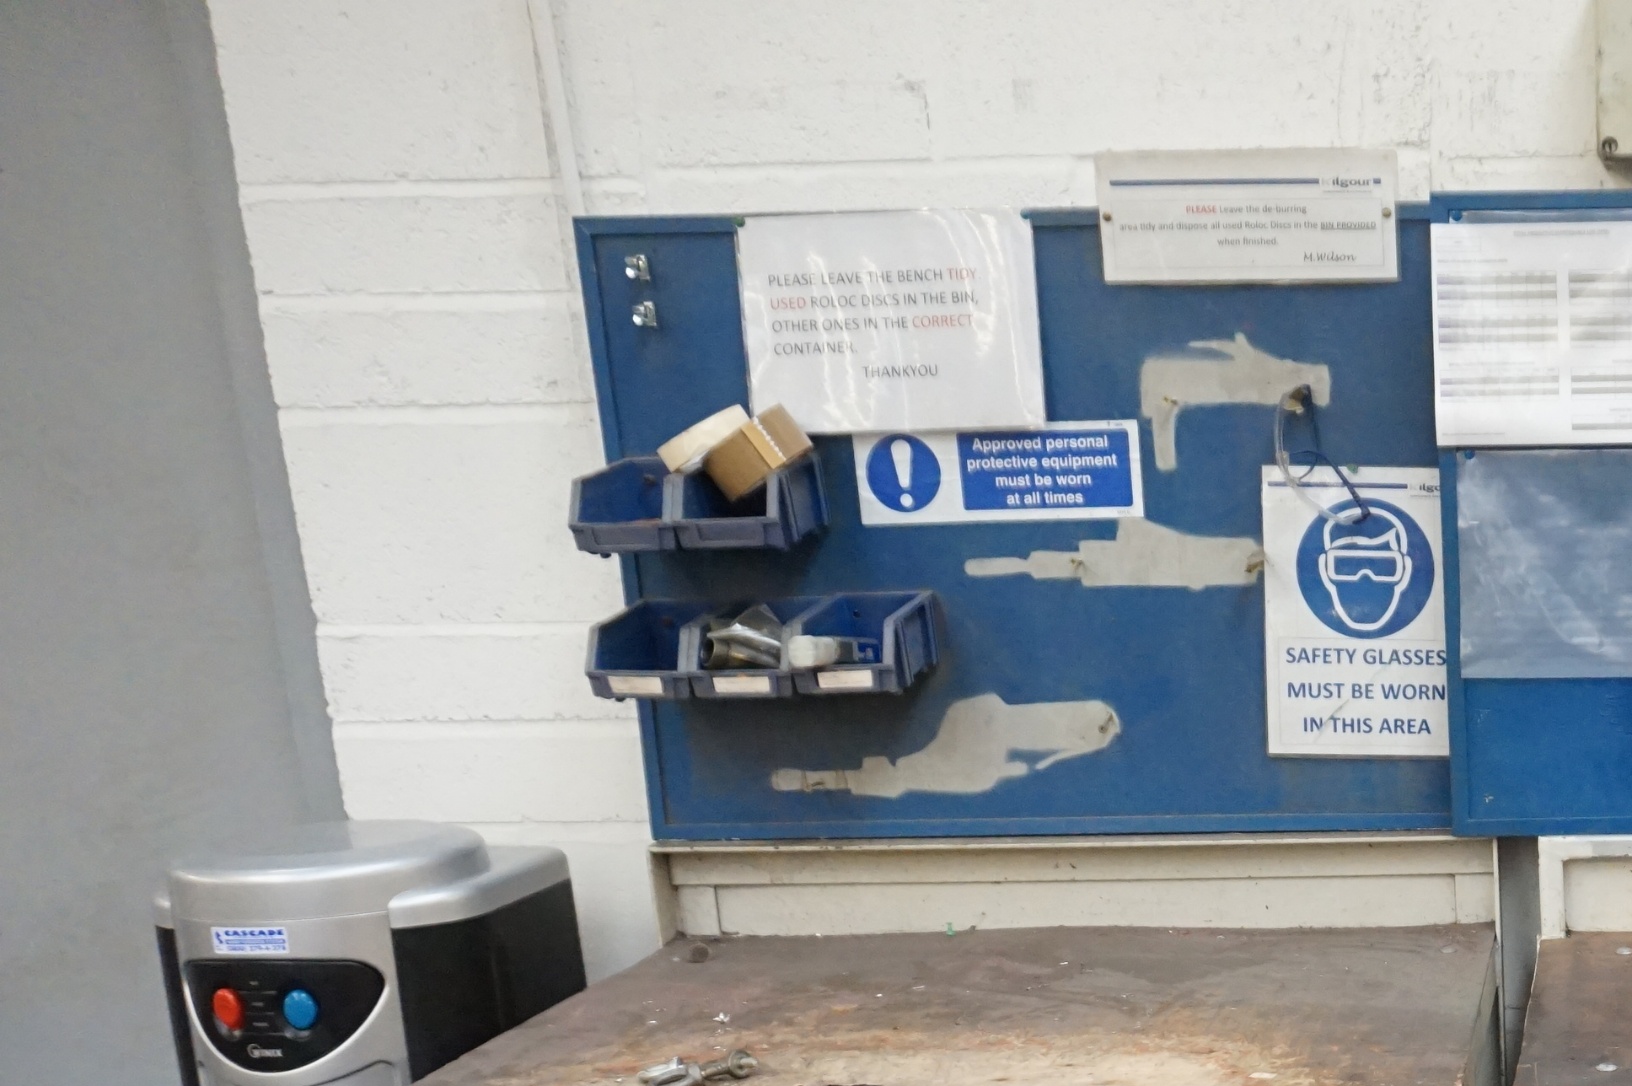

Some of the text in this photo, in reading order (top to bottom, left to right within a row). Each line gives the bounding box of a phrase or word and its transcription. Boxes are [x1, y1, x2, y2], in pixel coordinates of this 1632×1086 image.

[1185, 205, 1217, 214] PLEASE
[1219, 205, 1243, 213] Leave
[1246, 205, 1260, 213] the
[1120, 220, 1376, 232] area tidy and dispose all used Roloc Discs in the BIN PROVIDED
[1217, 238, 1240, 247] when
[768, 273, 816, 288] PLEASE
[820, 271, 863, 286] LEAVE
[866, 269, 893, 284] THE
[897, 267, 943, 283] BENCH
[769, 290, 979, 310] USED ROLOC DISCS IN THE BIN,
[772, 314, 974, 333] OTHER ONES IN THE CORRECT
[773, 341, 858, 356] CONTAINER.
[862, 364, 938, 379] THANKYOU
[972, 435, 1108, 453] Approved personal
[966, 453, 1118, 472] protective equipment
[995, 474, 1092, 487] must be worn
[1006, 491, 1084, 506] at all times
[1286, 647, 1447, 666] SAFETY GLASSES
[1287, 682, 1446, 700] MUST BE WORN
[1303, 717, 1432, 735] IN THIS AREA
[224, 929, 284, 937] CASCADE
